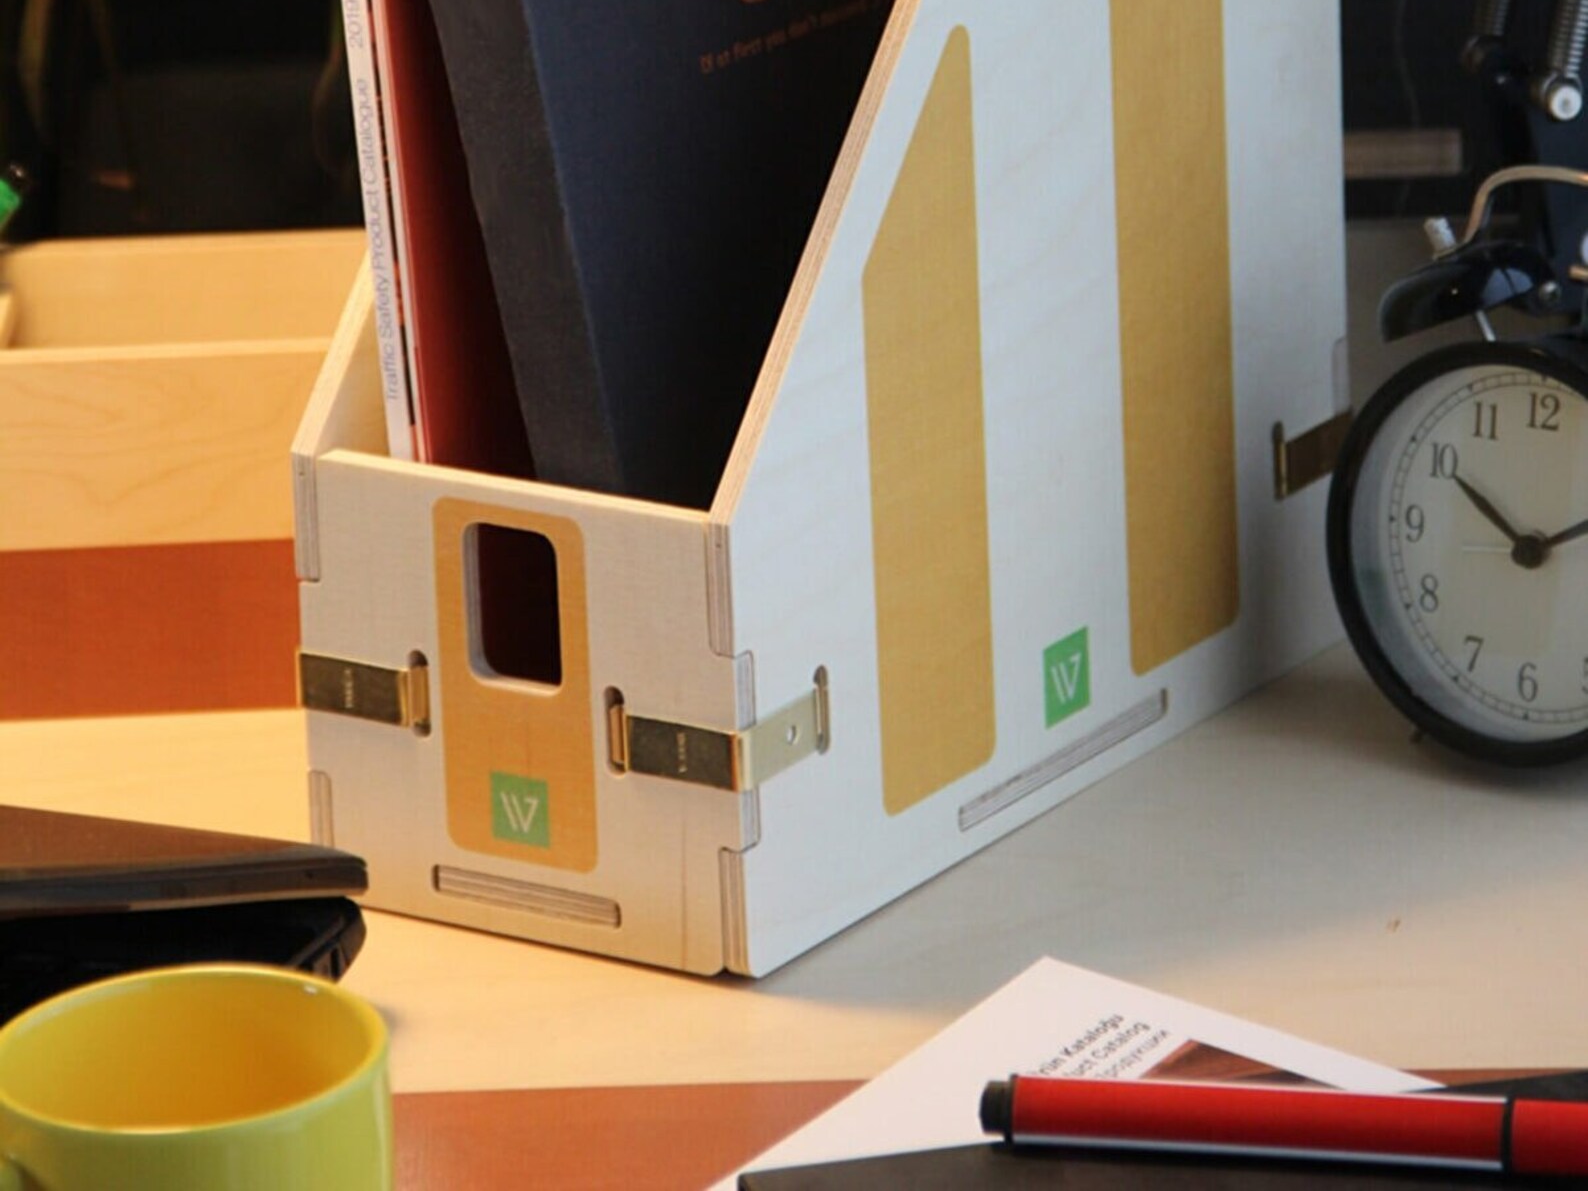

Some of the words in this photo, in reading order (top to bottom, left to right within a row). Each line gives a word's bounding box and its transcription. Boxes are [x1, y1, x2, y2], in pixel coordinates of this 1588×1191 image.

[356, 78, 377, 186] Catalogue
[365, 189, 386, 268] Product
[375, 273, 394, 339] Safety
[382, 342, 399, 401] Traffic
[1471, 400, 1499, 441] 11
[1526, 392, 1561, 432] 12
[1429, 442, 1459, 479] 10
[1405, 504, 1425, 543] 9
[1419, 573, 1438, 613] 8
[1463, 635, 1485, 673] 7
[1516, 662, 1538, 703] 6
